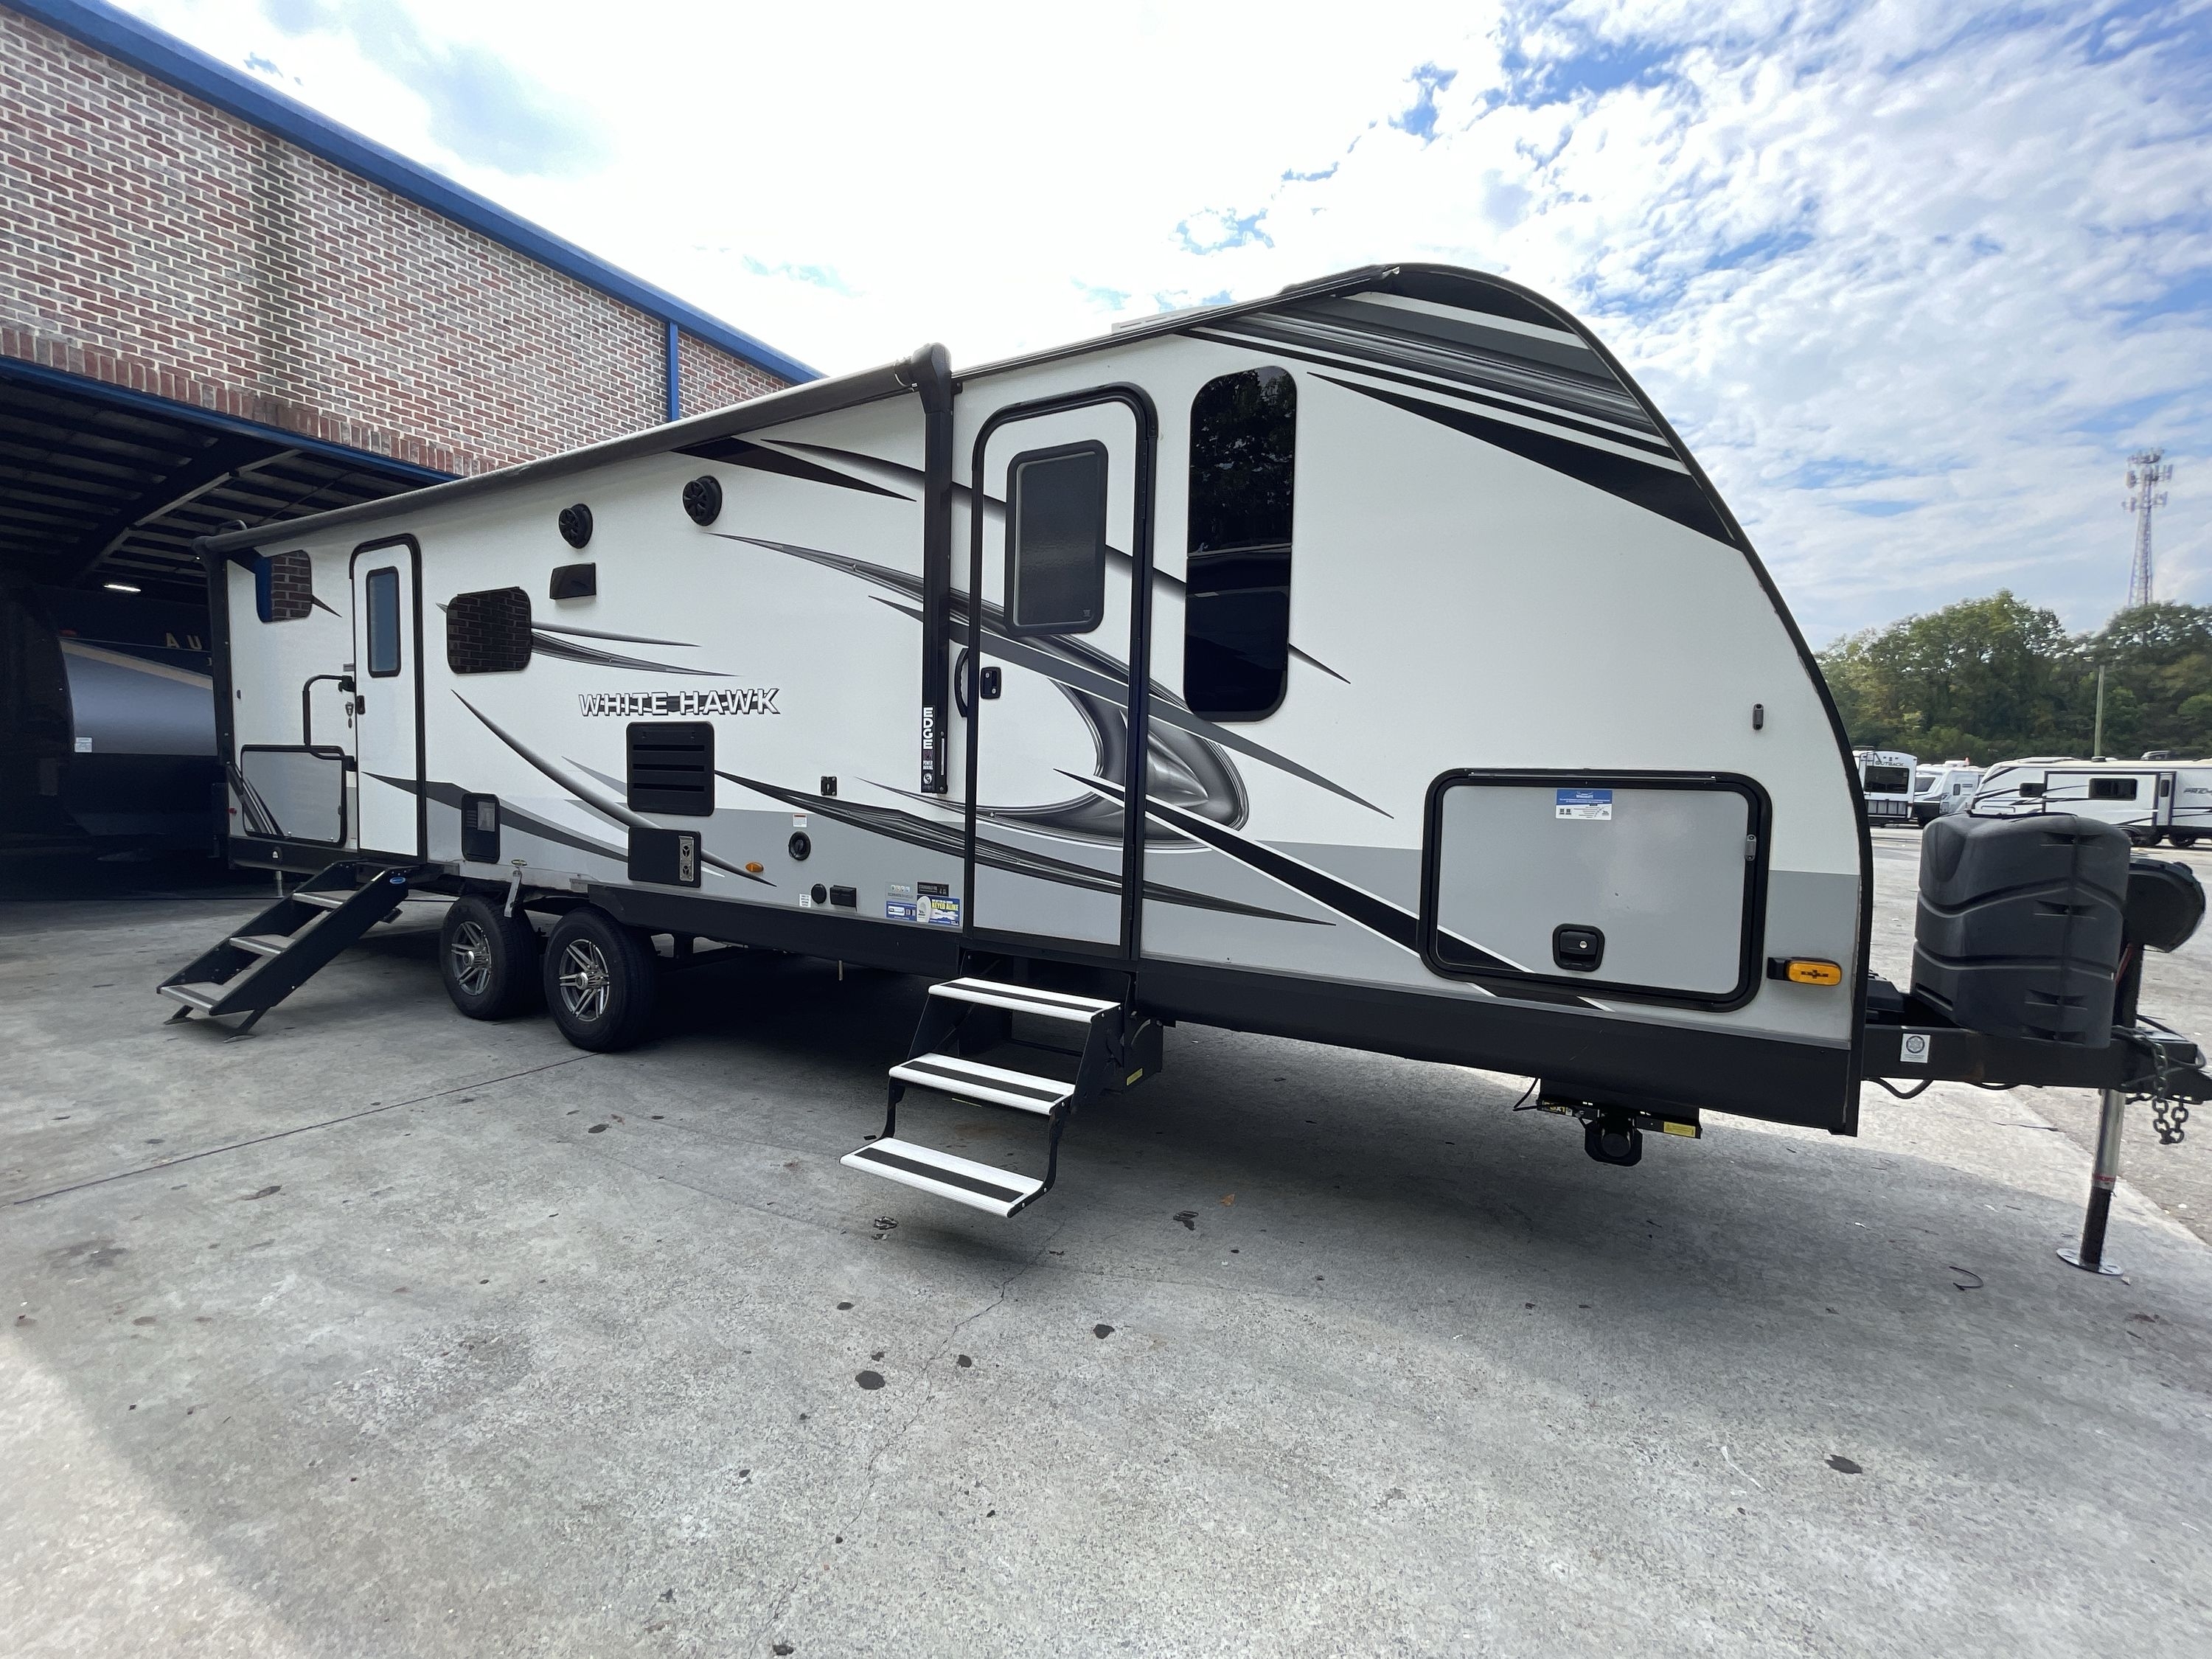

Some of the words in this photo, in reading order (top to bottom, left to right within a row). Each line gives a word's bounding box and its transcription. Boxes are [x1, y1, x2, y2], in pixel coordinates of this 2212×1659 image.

[578, 692, 668, 716] WHITE
[680, 688, 781, 714] HAWK
[922, 707, 933, 749] EDGE
[932, 901, 946, 910] KEYED
